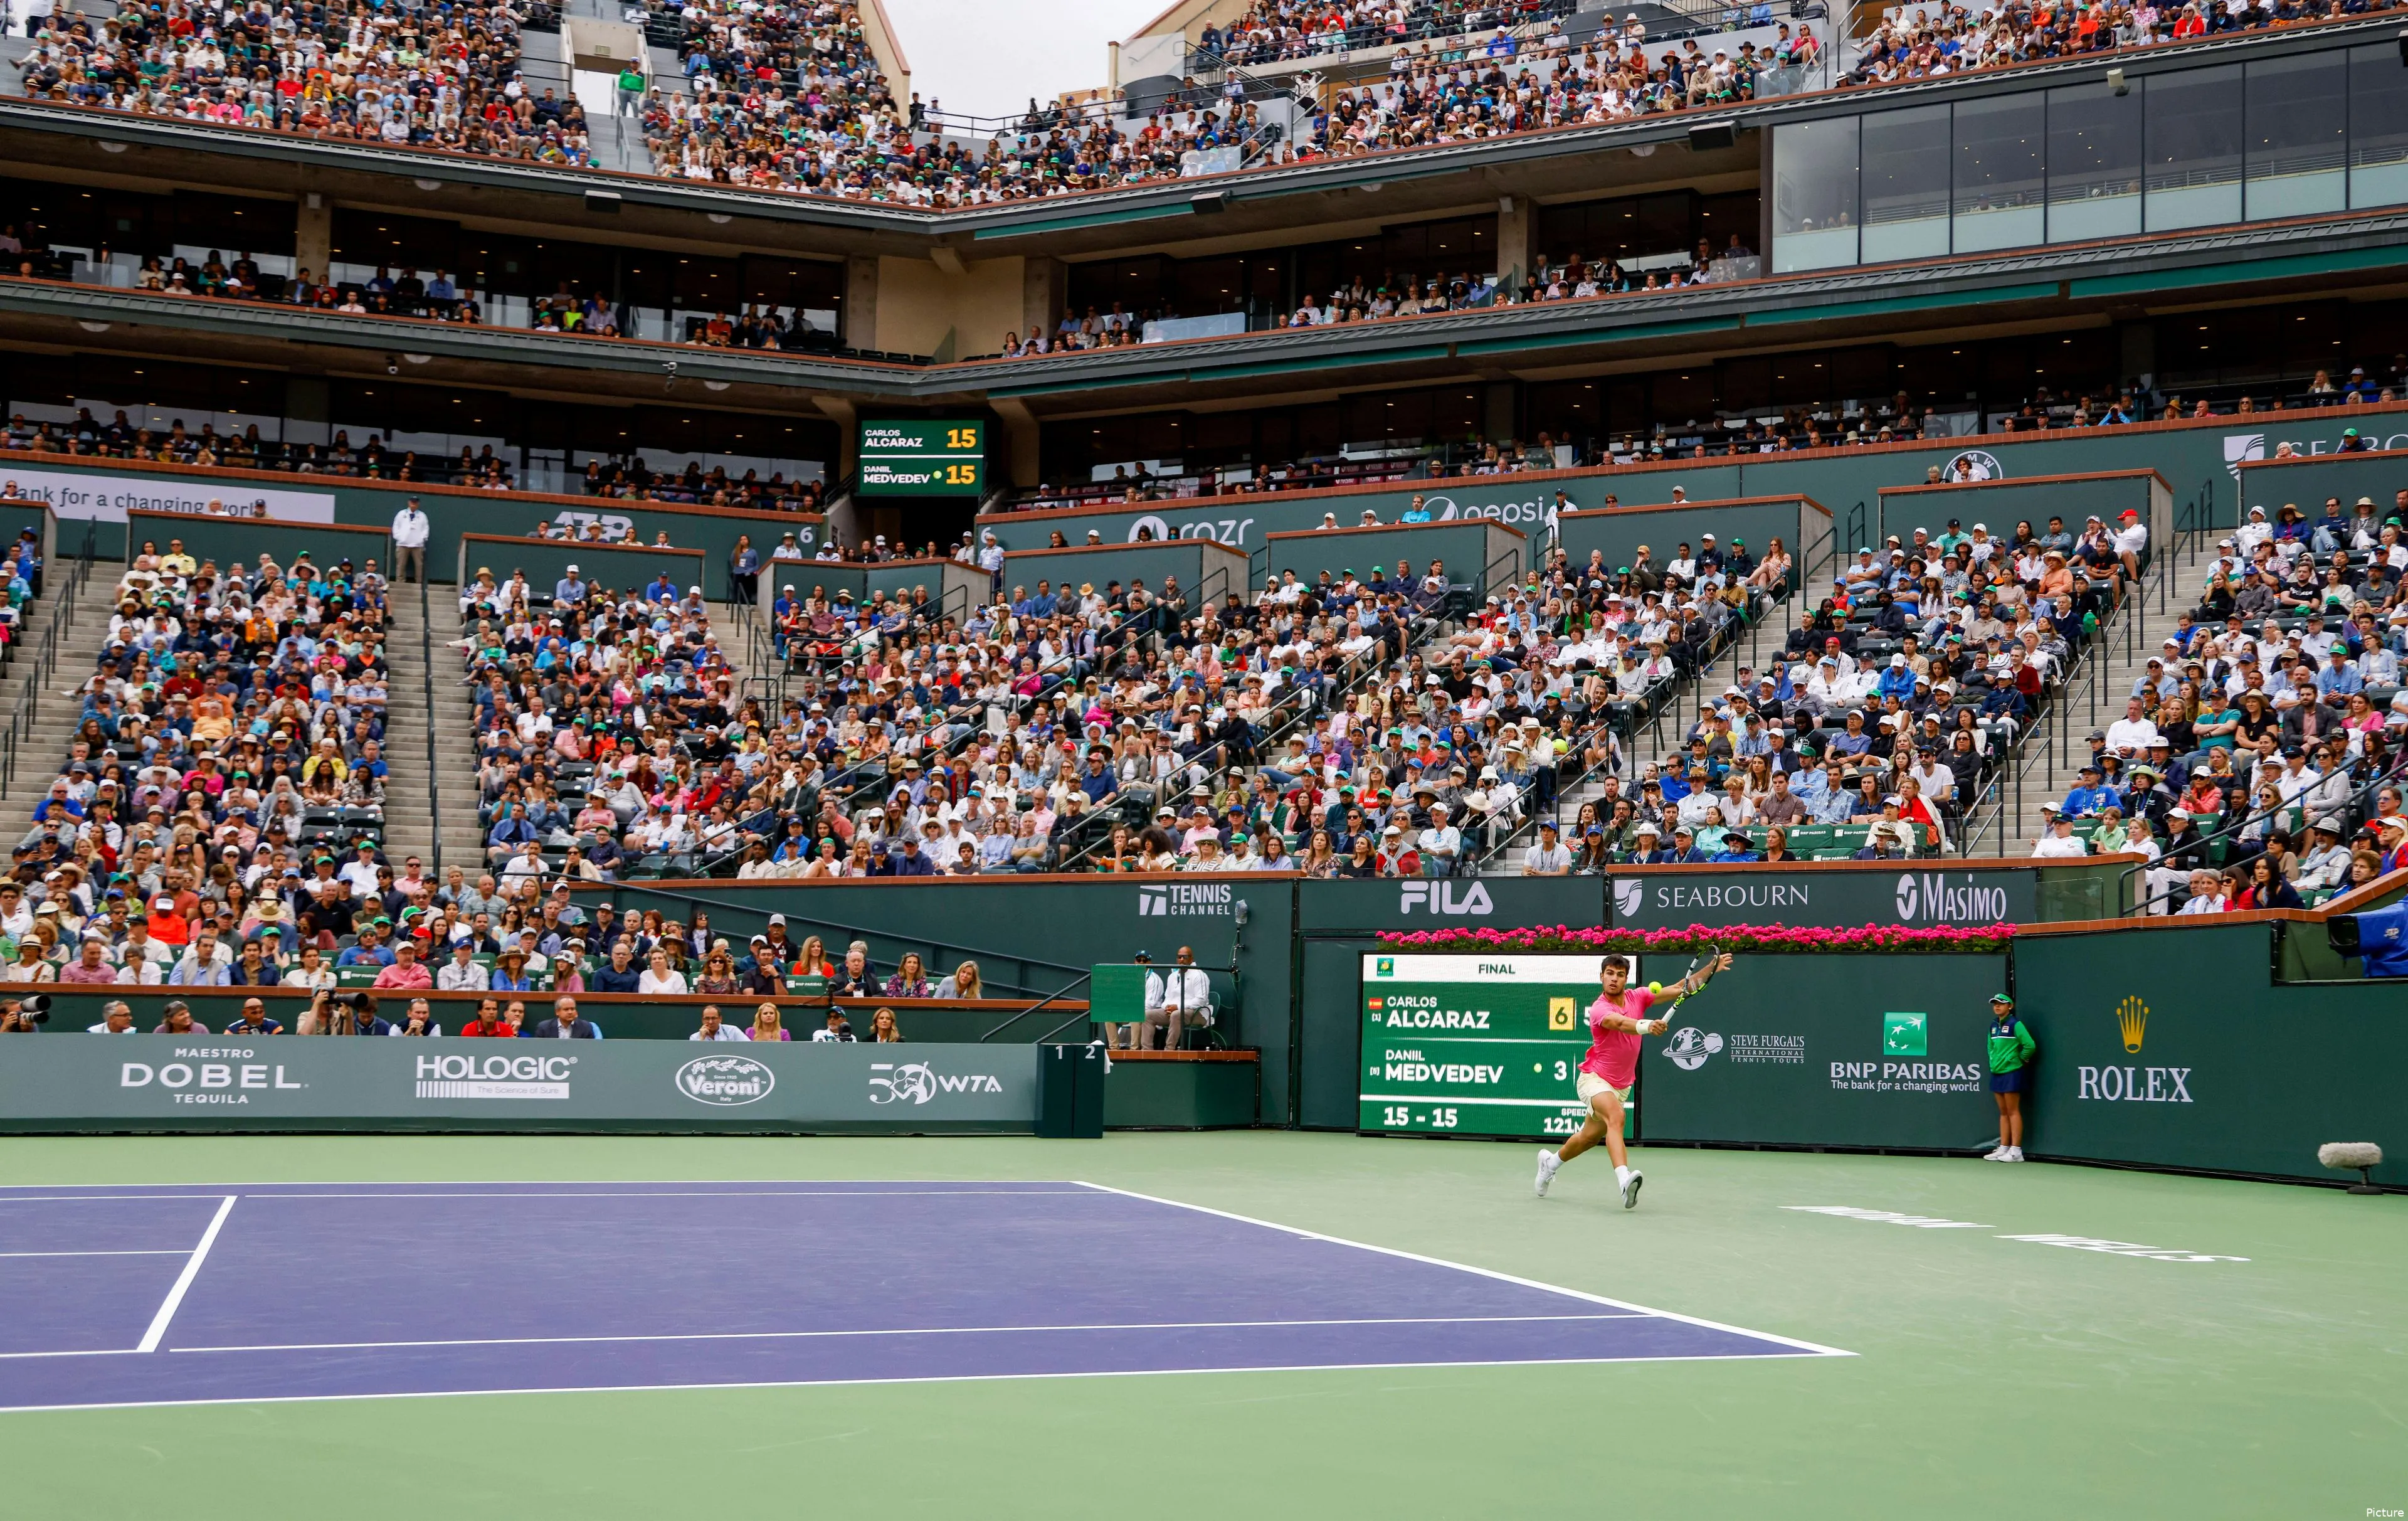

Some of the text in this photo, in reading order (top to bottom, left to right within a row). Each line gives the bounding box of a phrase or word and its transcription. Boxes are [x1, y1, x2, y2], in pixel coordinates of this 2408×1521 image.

[864, 437, 923, 447] ALCARAZ
[947, 428, 976, 448] 15
[863, 474, 931, 484] MEDVEDEV
[946, 465, 976, 484] 15
[19, 486, 54, 502] ank
[59, 487, 90, 507] for
[97, 494, 108, 506] a
[115, 493, 204, 514] changing
[544, 511, 633, 542] ATP
[800, 526, 813, 543] 6
[1170, 884, 1231, 903] TENNIS
[1401, 880, 1493, 914] FILA
[1657, 885, 1809, 908] SEABOURN
[1171, 905, 1230, 915] CHANNEL
[1479, 963, 1515, 974] FINAL
[1387, 996, 1437, 1007] CARLOS
[1386, 1009, 1490, 1029] ALCARAZ
[1555, 1006, 1568, 1025] 6
[1731, 1035, 1804, 1047] STEVE FURGAL'S
[174, 1048, 255, 1058] MAESTRO
[1055, 1045, 1063, 1059] 1
[1085, 1045, 1096, 1059] 2
[1385, 1049, 1425, 1061] DANIIL
[120, 1063, 302, 1088] DOBEL
[416, 1055, 571, 1080] HOLOGIC
[1385, 1063, 1504, 1084] MEDVEDEV
[1554, 1060, 1567, 1081] 3
[1830, 1062, 1981, 1081] BNP PARIBAS
[685, 1074, 761, 1096] Veroni
[938, 1075, 1002, 1093] WTA
[1830, 1079, 1849, 1089] The
[1851, 1080, 1875, 1090] bank
[1877, 1080, 1892, 1092] for
[1903, 1082, 1948, 1093] changing
[1950, 1082, 1980, 1092] world
[2078, 1066, 2194, 1103] ROLEX
[174, 1094, 249, 1104] TEQUILA
[1384, 1106, 1409, 1126] 15
[1432, 1107, 1457, 1128] 15
[1561, 1108, 1587, 1116] SPEED
[1992, 1234, 2252, 1262] WELLS
